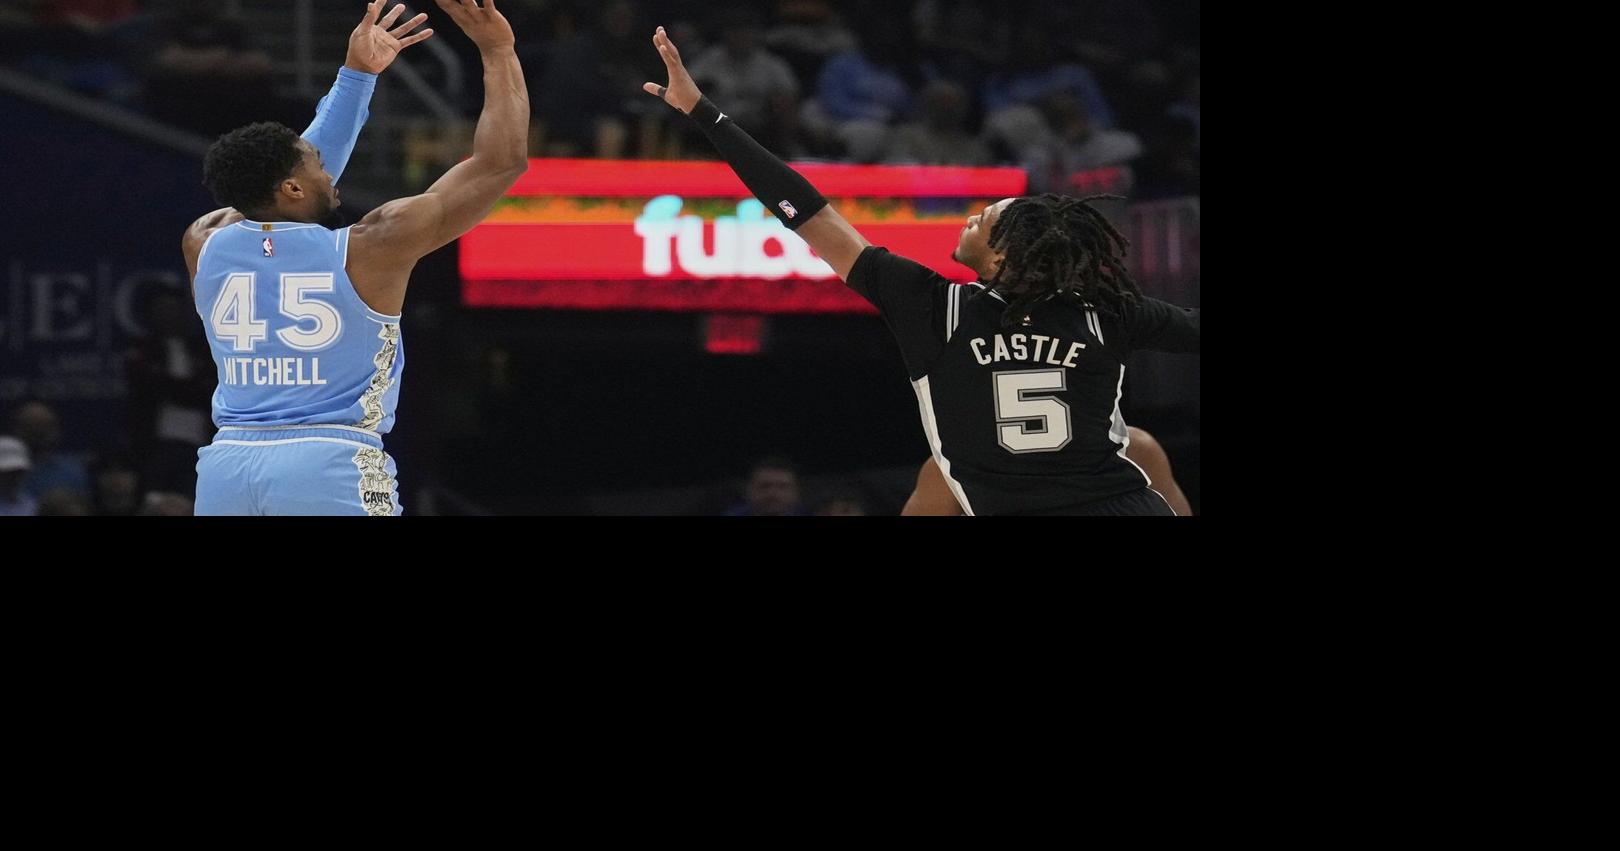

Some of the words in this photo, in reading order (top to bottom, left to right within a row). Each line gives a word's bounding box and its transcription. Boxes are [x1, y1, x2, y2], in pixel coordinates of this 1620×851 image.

[211, 271, 342, 351] 45
[970, 333, 1086, 368] CASTLE
[992, 367, 1073, 455] 5
